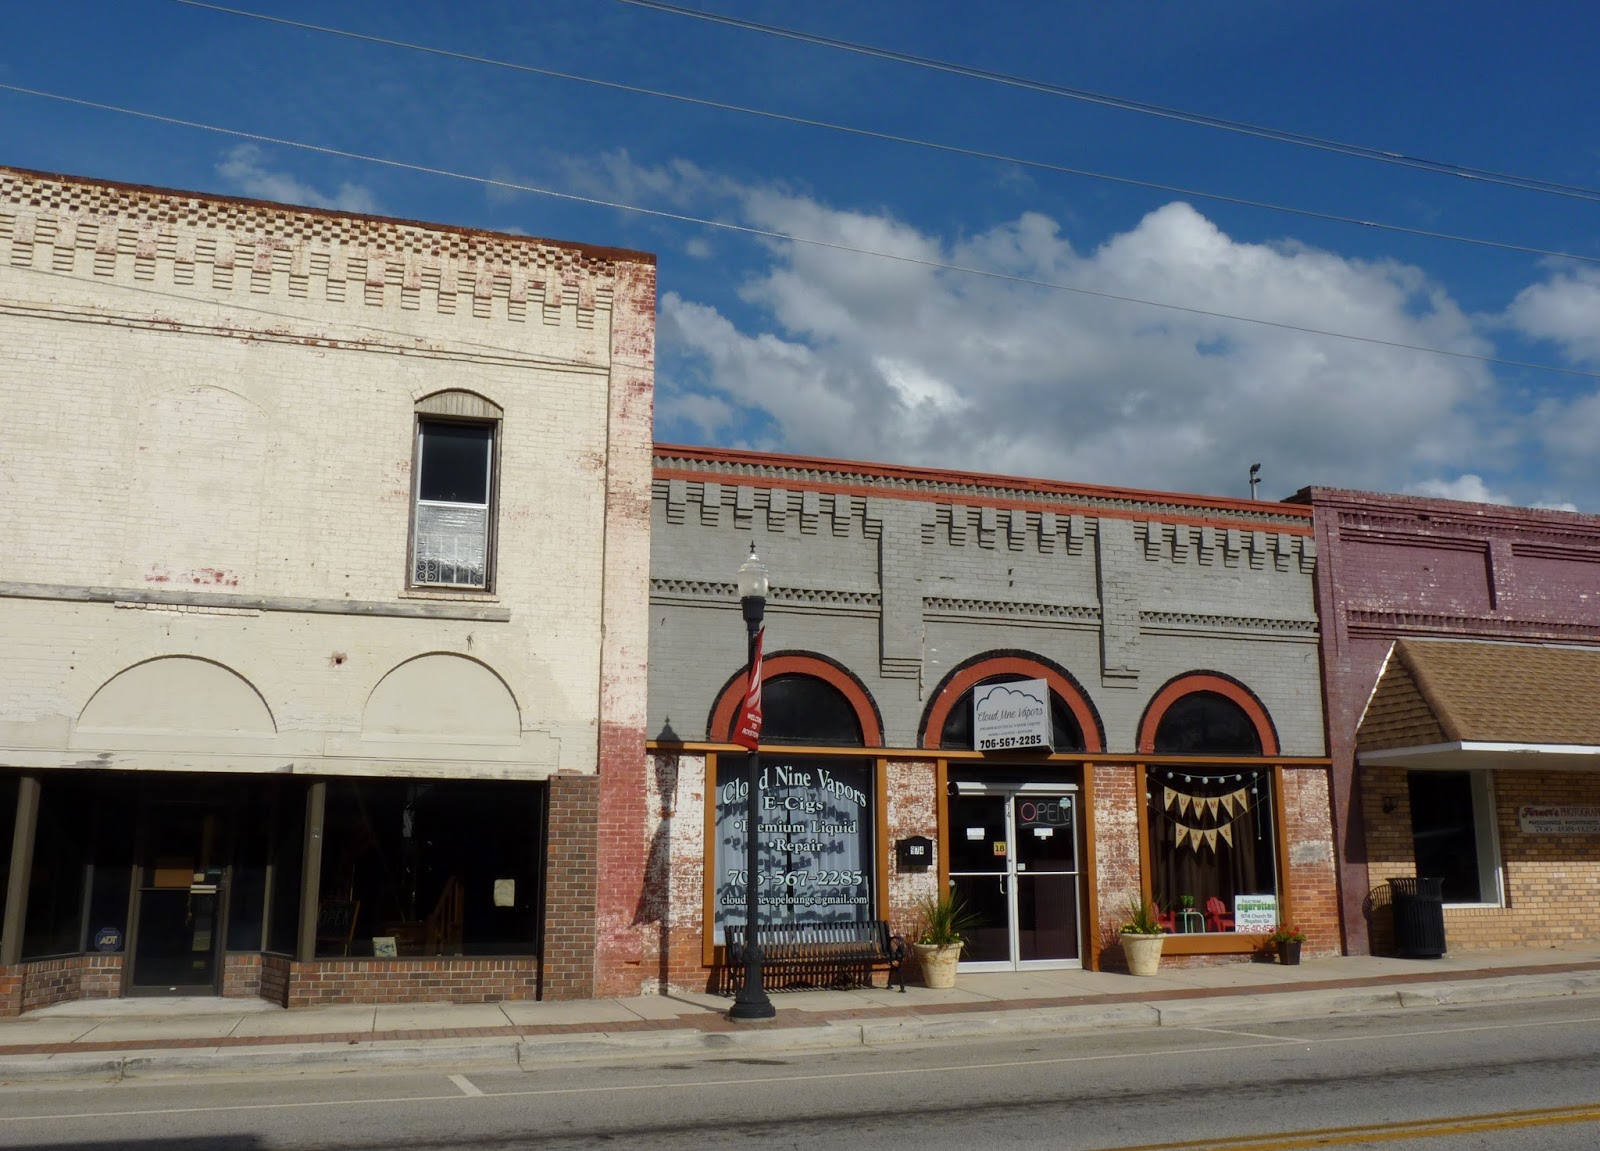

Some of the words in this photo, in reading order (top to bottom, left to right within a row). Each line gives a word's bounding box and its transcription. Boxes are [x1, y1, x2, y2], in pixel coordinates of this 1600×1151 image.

[722, 767, 769, 805] Clod
[775, 765, 811, 787] Nine
[817, 768, 867, 808] Vapors
[763, 796, 824, 813] E-Cigs
[1166, 792, 1245, 809] SUMMER
[1021, 802, 1070, 821] OPEN
[741, 819, 806, 833] Pemium
[811, 819, 858, 836] Liquid
[1178, 828, 1230, 841] SALE
[775, 838, 823, 855] Repair
[995, 844, 1005, 852] 18
[728, 870, 863, 886] 706-567-2285
[721, 893, 868, 907] cloudnevapelounge@gmail.com
[1237, 902, 1275, 912] cigarettes
[99, 935, 118, 945] ADT
